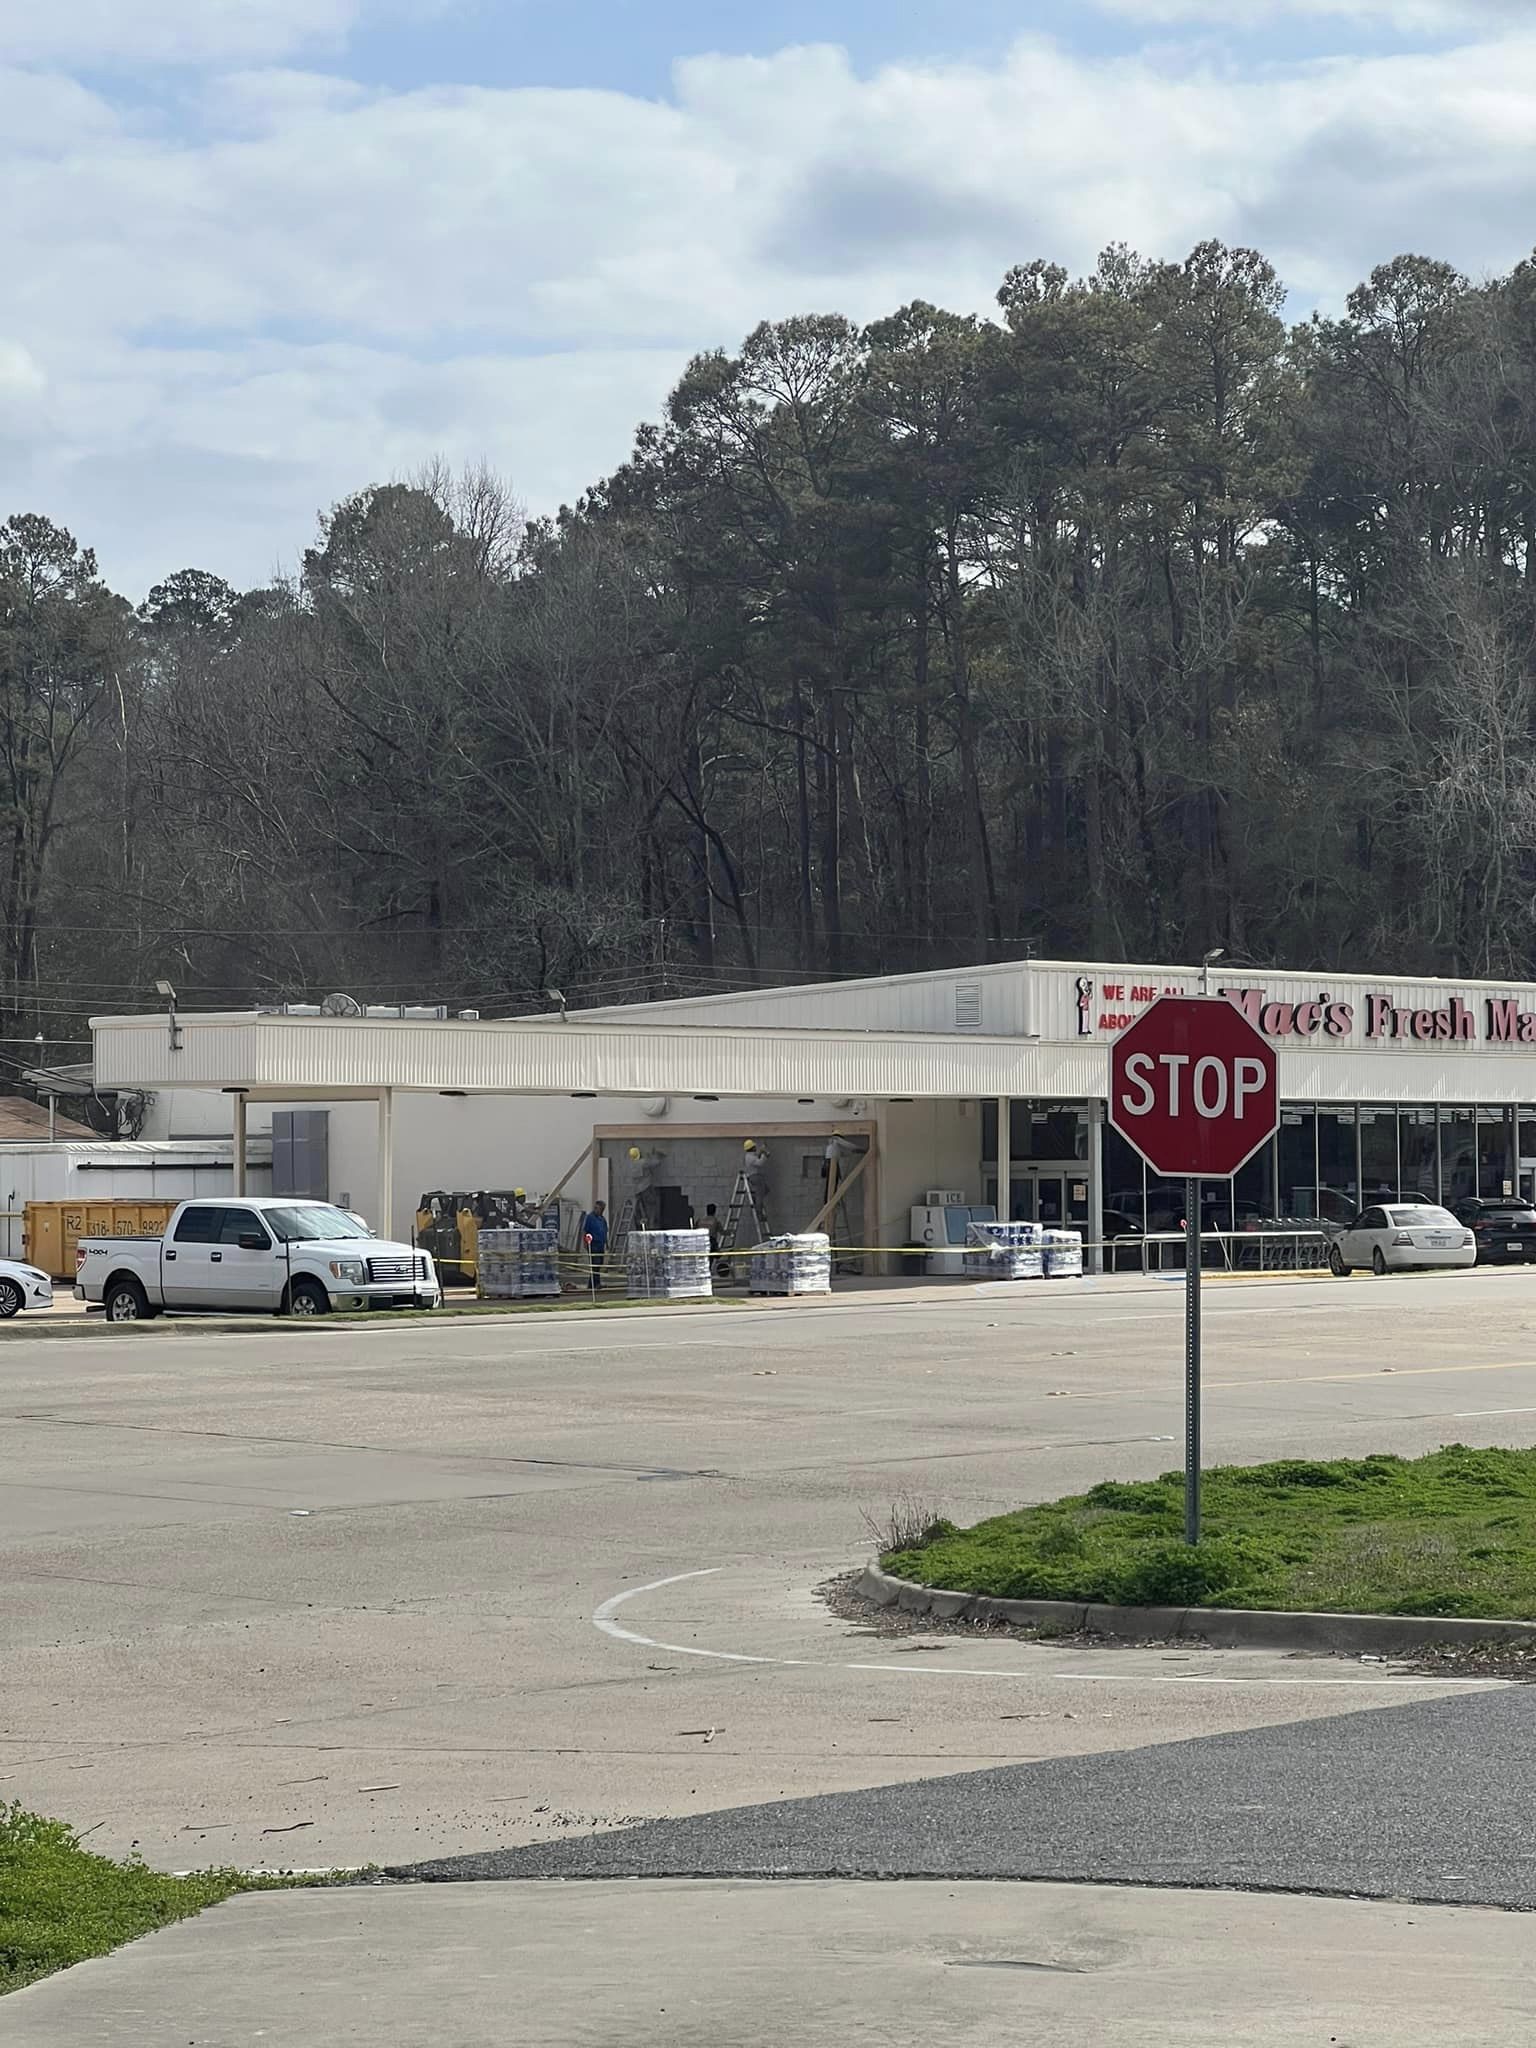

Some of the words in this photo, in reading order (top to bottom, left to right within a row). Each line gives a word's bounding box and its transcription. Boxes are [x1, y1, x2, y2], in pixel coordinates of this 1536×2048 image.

[1102, 984, 1125, 1001] WE
[1218, 988, 1354, 1038] Mac's
[1365, 994, 1476, 1041] Fresh
[1122, 1052, 1267, 1120] STOP
[945, 1193, 961, 1204] ICE
